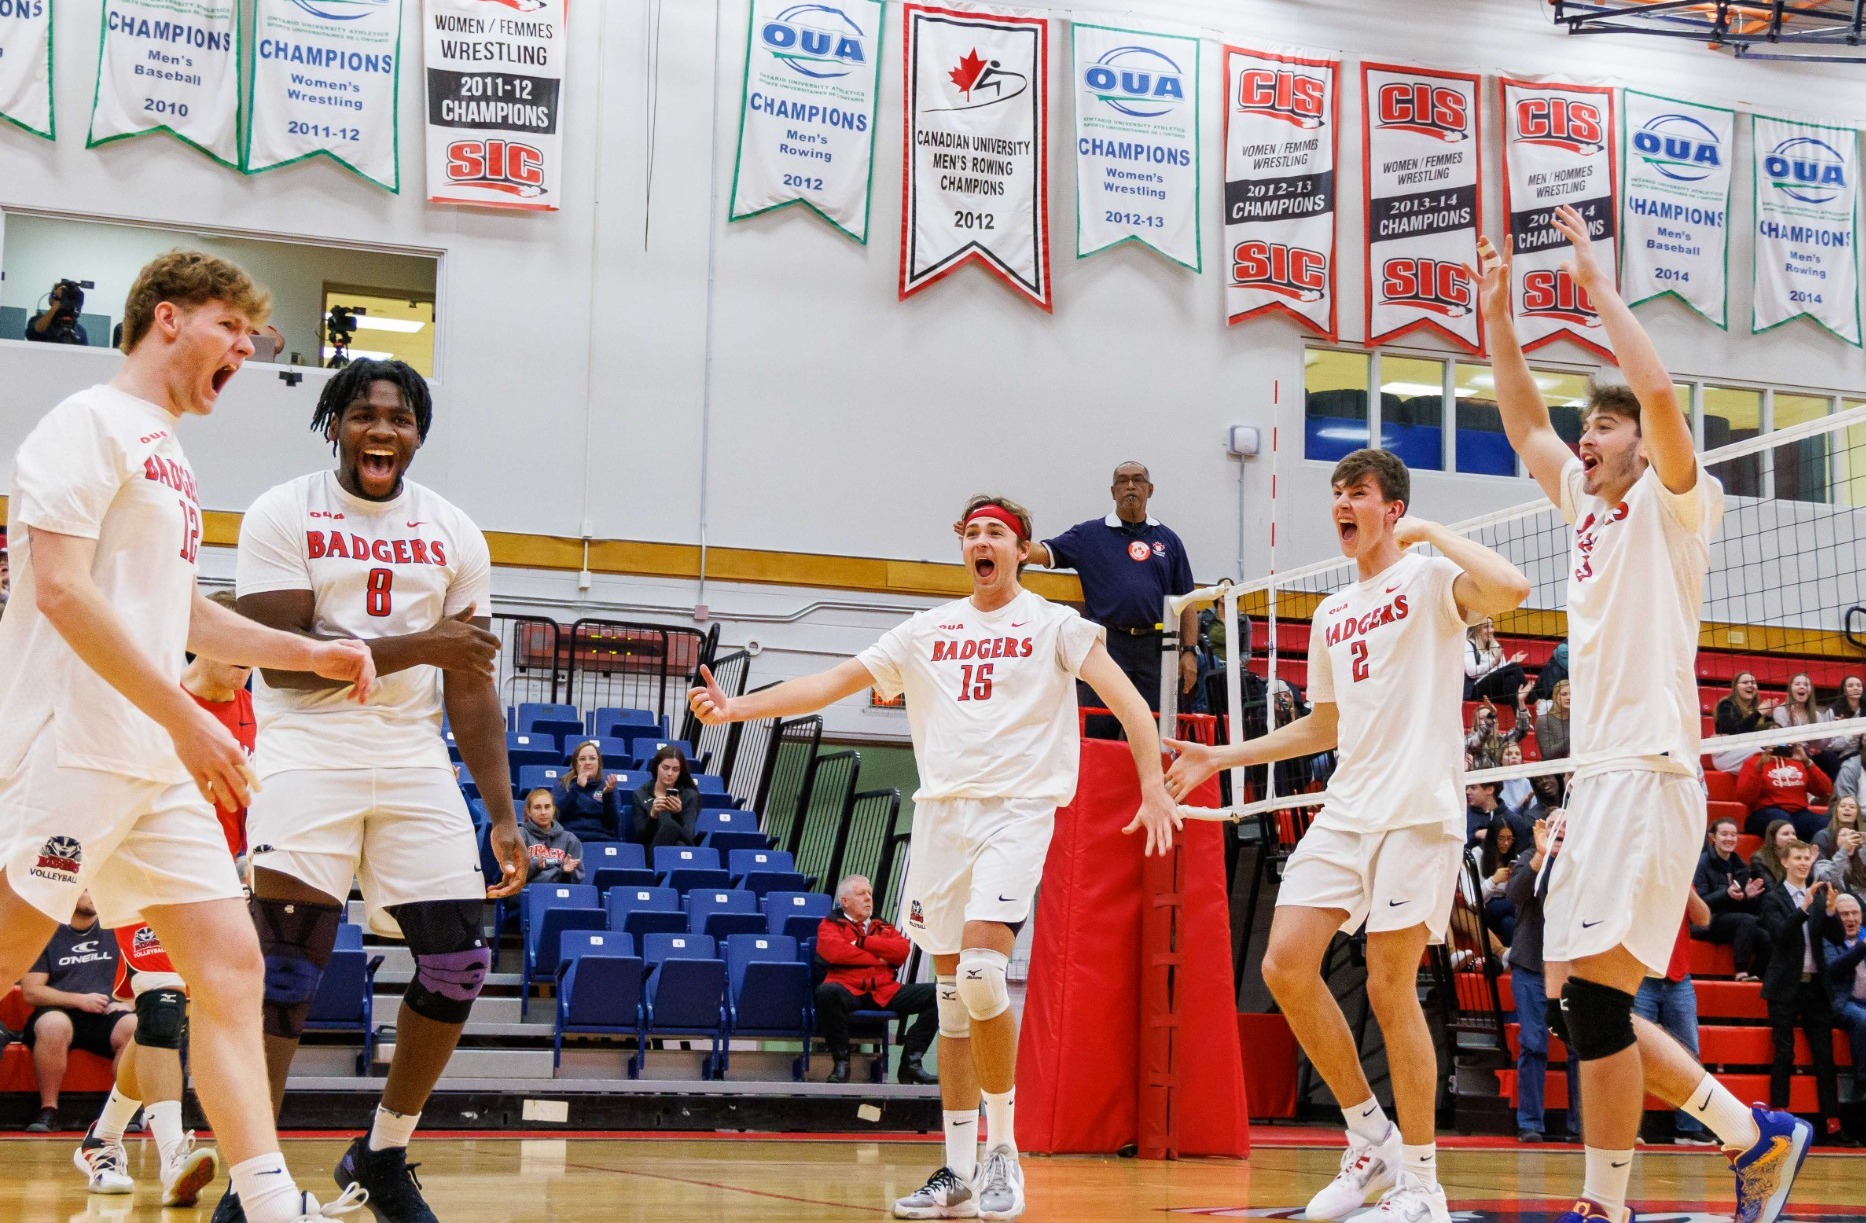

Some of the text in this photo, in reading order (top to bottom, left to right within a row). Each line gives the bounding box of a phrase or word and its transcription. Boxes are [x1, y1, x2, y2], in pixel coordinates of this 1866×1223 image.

[108, 11, 231, 52] CHAMPIONS
[435, 14, 484, 34] WOMEN
[500, 19, 553, 39] FEMMES
[441, 39, 547, 66] WRESTLING
[761, 22, 866, 64] OUA
[148, 50, 193, 67] Men's
[260, 39, 393, 74] CHAMPIONS
[134, 65, 202, 86] Baseball
[291, 73, 360, 93] Women's
[1085, 65, 1185, 101] OUA
[461, 76, 532, 100] 2011-12
[1239, 69, 1325, 118] CIS
[144, 98, 189, 117] 2010
[288, 89, 363, 111] Wrestling
[1379, 82, 1467, 132] CIS
[442, 100, 549, 128] CHAMPIONS
[750, 92, 868, 132] CHAMPIONS
[1516, 98, 1603, 144] CIS
[288, 121, 360, 141] 2011-12
[786, 129, 828, 145] Men's
[779, 143, 832, 163] Rowing
[917, 130, 1031, 156] CANADIAN UNIVERSITY
[1079, 138, 1190, 167] CHAMPIONS
[1242, 144, 1276, 157] WOMEN
[1632, 130, 1723, 167] OUA
[447, 139, 544, 186] SIC
[932, 152, 1013, 176] MEN'S ROWING
[1253, 153, 1308, 170] WRESTLING
[1383, 157, 1418, 174] WOMEN
[1425, 151, 1463, 168] FEMMES
[1764, 154, 1847, 189] OUA
[783, 173, 823, 191] 2012
[940, 175, 1005, 196] CHAMPIONS
[1106, 167, 1164, 183] Women's
[1397, 167, 1450, 185] WRESTLING
[1528, 172, 1548, 187] MEN
[1553, 165, 1593, 183] HOMMES
[1104, 182, 1166, 200] Wrestling
[1247, 180, 1312, 197] 2012-13
[1536, 179, 1586, 199] WRESTLING
[1232, 194, 1325, 219] CHAMPIONS
[1389, 194, 1458, 215] 2013-14
[1528, 204, 1596, 228] 201-14
[954, 210, 995, 230] 2012
[1105, 211, 1164, 228] 2012-13
[1379, 207, 1471, 236] CHAMPIONS
[1657, 227, 1692, 241] Men's
[1647, 239, 1701, 256] Baseball
[1790, 250, 1821, 264] Men's
[1232, 240, 1326, 291] SIC
[1655, 267, 1689, 282] 2014
[1785, 262, 1827, 280] Rowing
[1383, 258, 1471, 307] SIC
[1789, 290, 1823, 304] 2014
[179, 499, 200, 564] 12
[306, 530, 447, 566] BADGERS
[366, 567, 393, 617] 8
[931, 637, 1033, 662] BADGERS
[1351, 640, 1369, 683] 2
[957, 663, 994, 701] 15
[30, 868, 77, 884] VOLLEYBALL
[59, 951, 112, 966] O'NEILL
